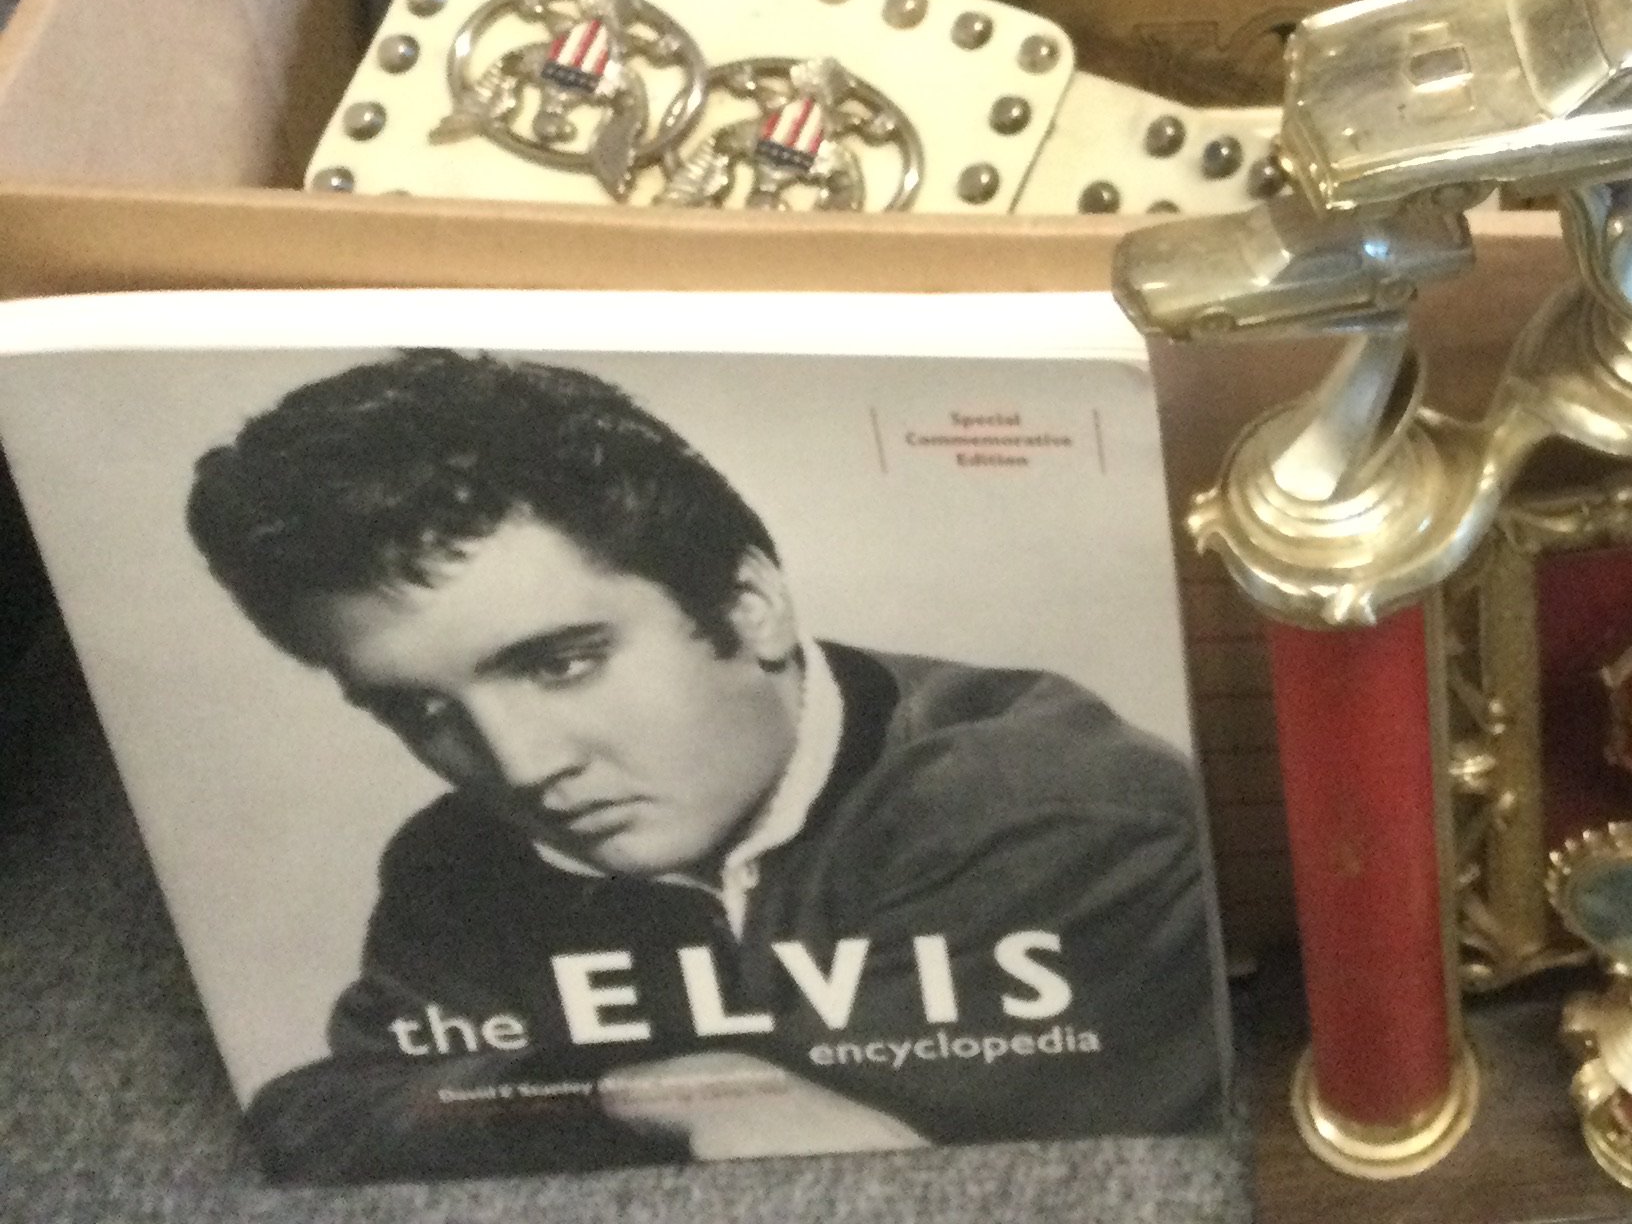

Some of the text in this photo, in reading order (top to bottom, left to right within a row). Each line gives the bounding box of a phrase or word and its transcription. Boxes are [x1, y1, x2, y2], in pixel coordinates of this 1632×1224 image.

[950, 411, 1020, 428] Special
[904, 431, 1072, 447] Commemorative
[956, 452, 1029, 467] Edition
[391, 930, 1075, 1057] the ELVIS
[807, 1026, 1103, 1072] encyclopedia
